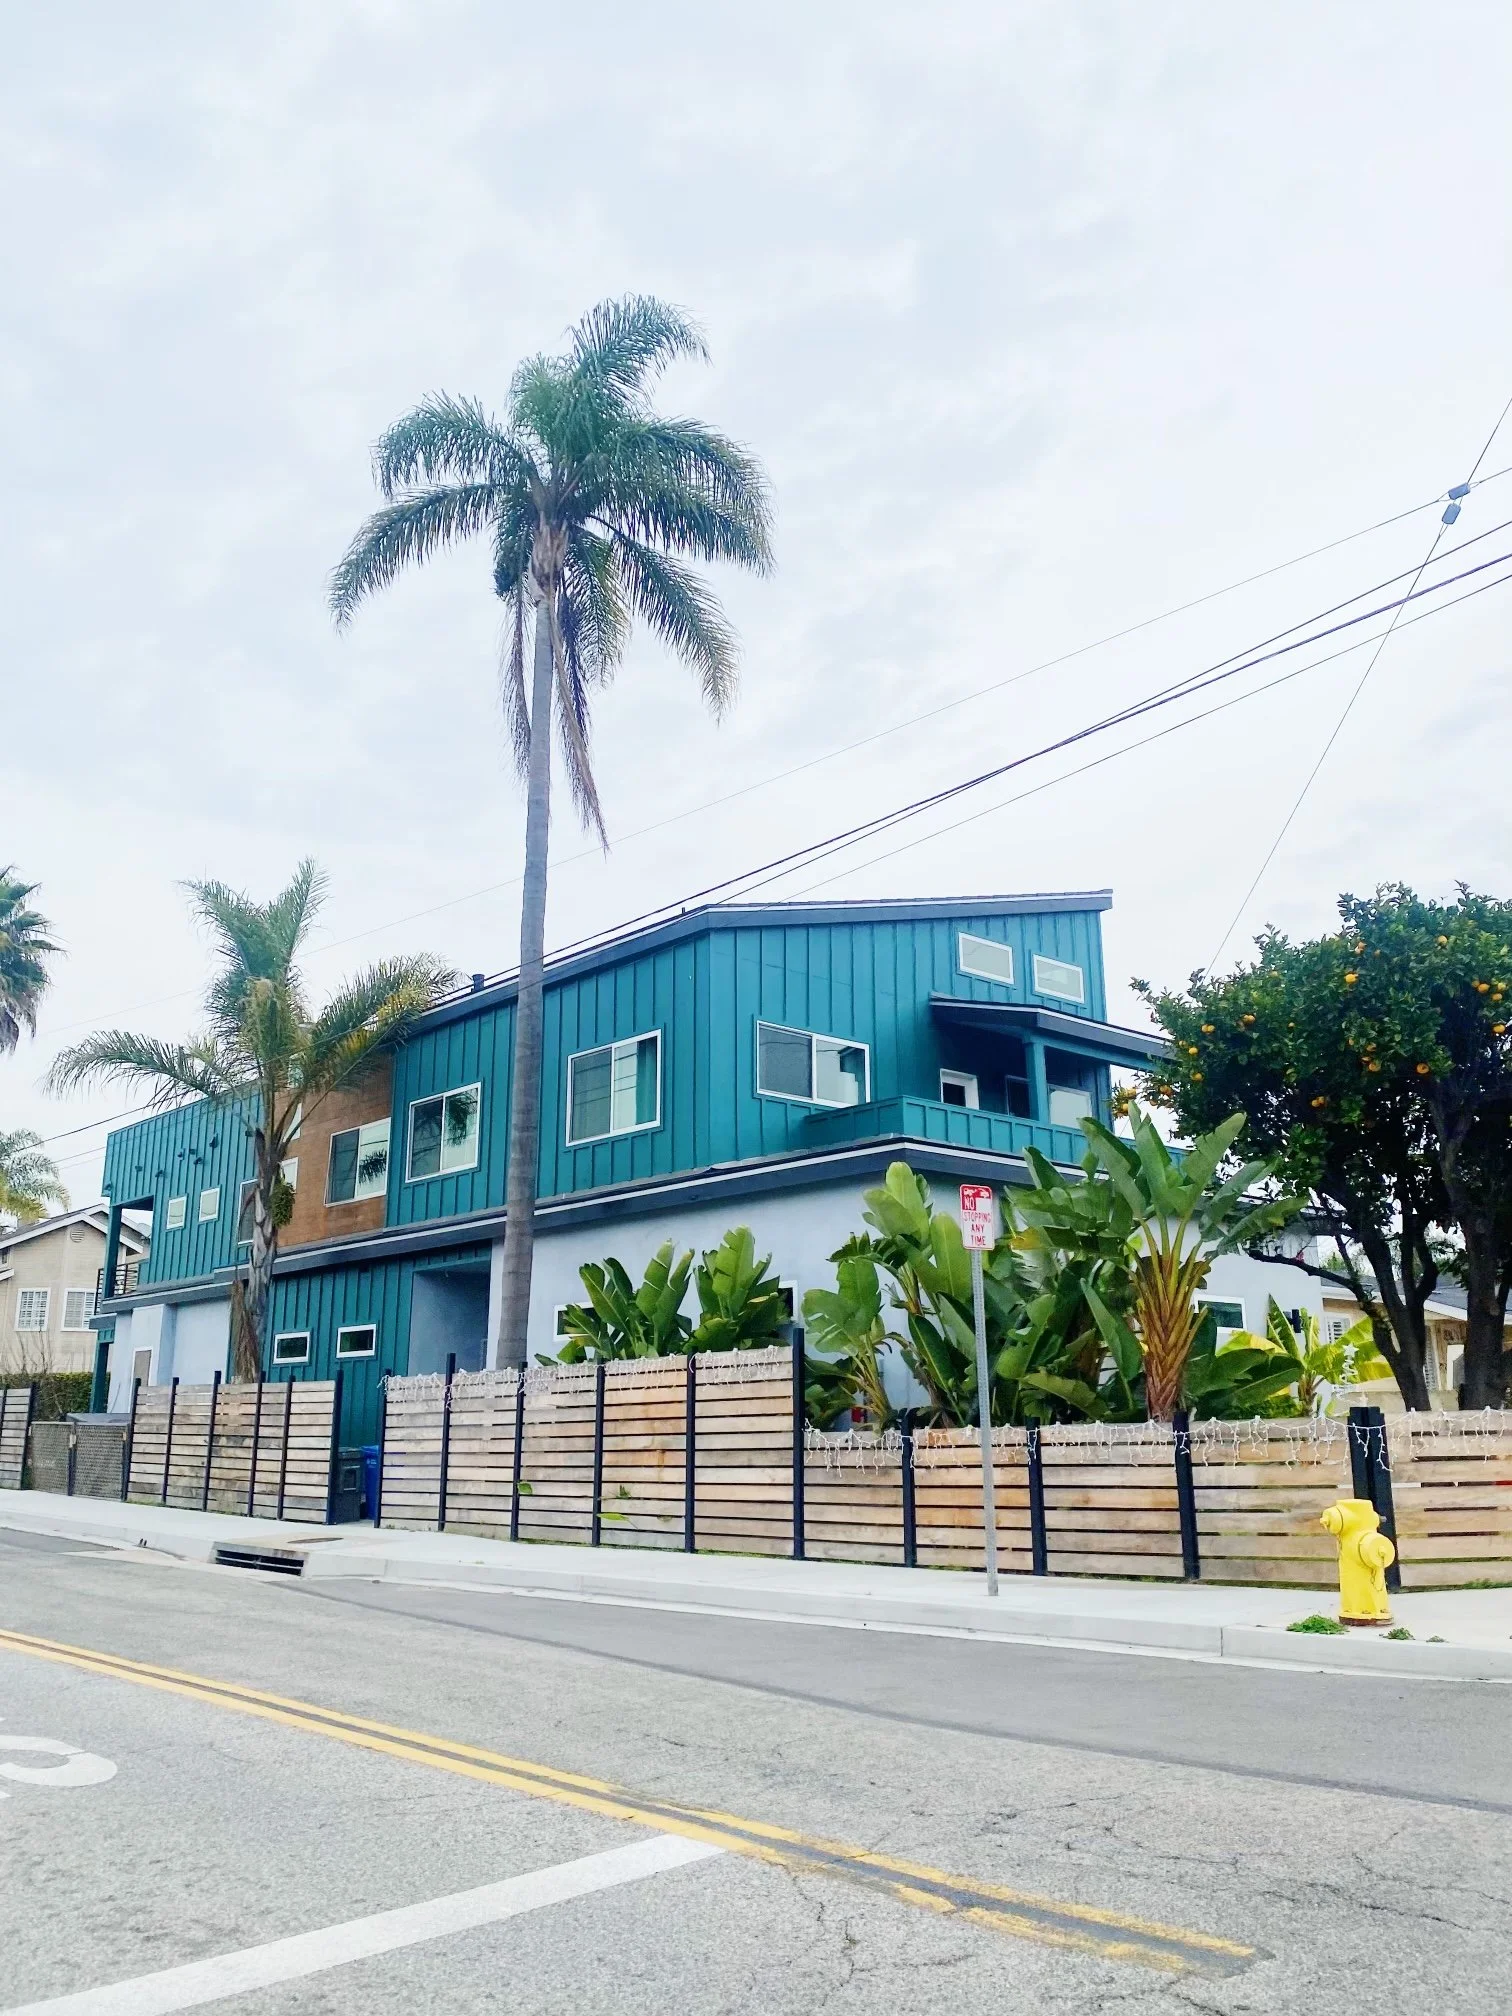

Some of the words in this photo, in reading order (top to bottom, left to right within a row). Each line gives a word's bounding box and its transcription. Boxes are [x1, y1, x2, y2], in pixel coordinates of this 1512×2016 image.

[964, 1196, 975, 1210] NO
[963, 1211, 991, 1223] STOPPING
[971, 1223, 985, 1233] ANY
[971, 1235, 986, 1246] TIME
